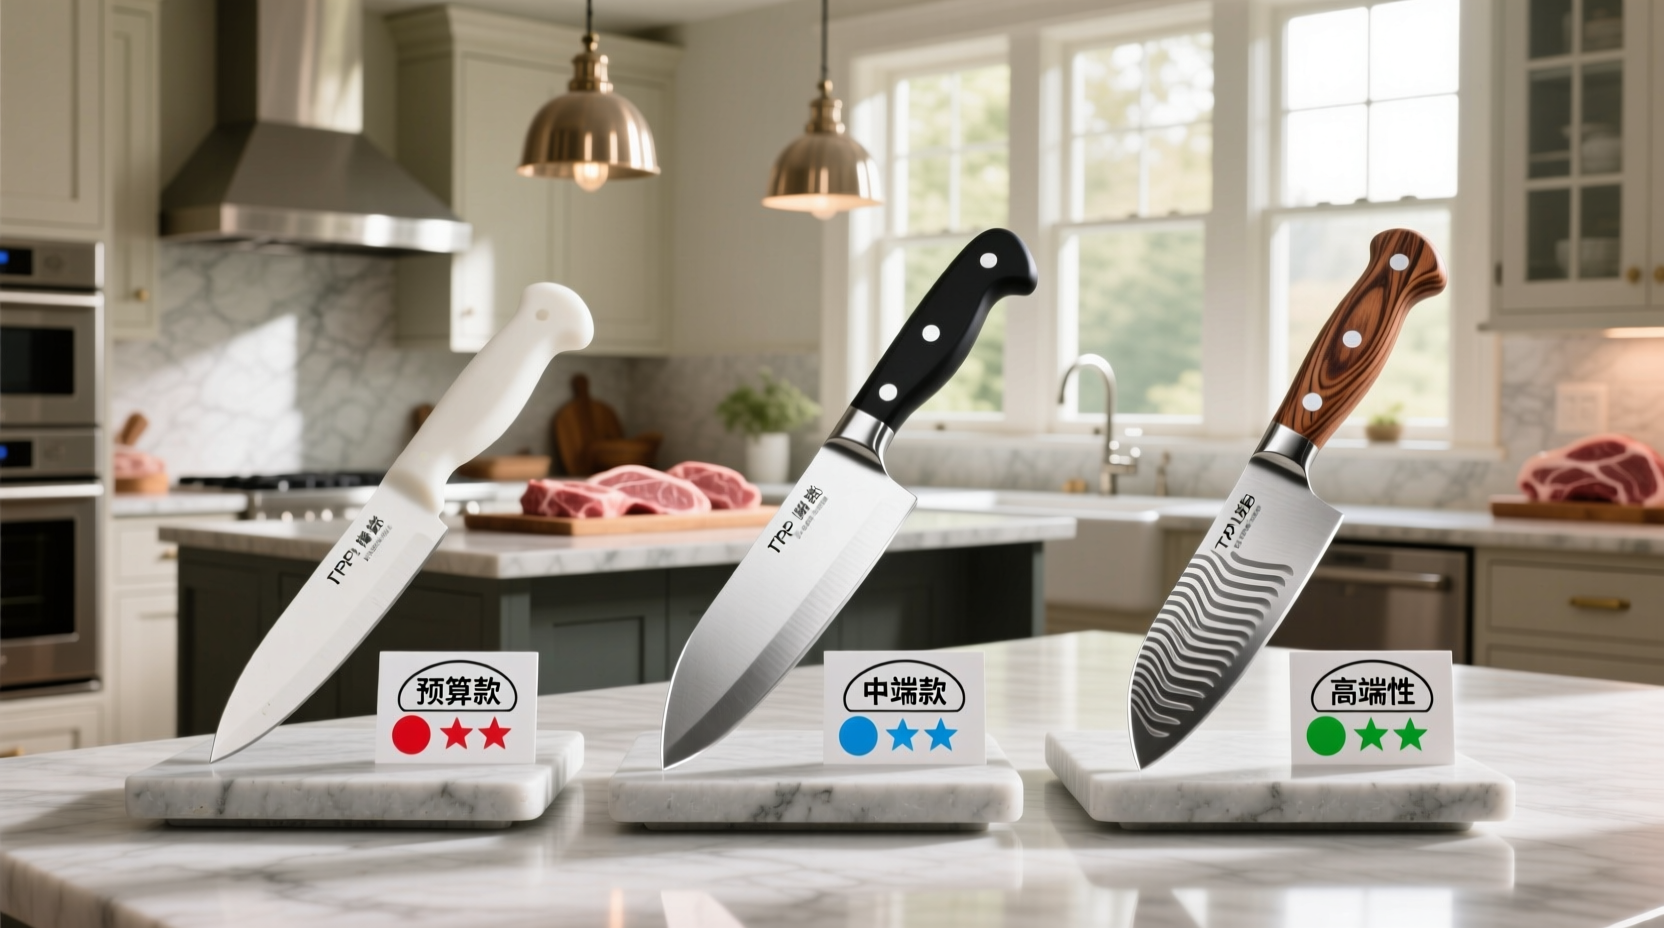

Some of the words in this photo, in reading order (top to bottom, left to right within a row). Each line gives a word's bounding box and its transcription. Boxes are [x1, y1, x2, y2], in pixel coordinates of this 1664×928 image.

[416, 676, 501, 706] 预算款
[864, 676, 947, 706] 中端款
[1330, 676, 1416, 706] 高端性
